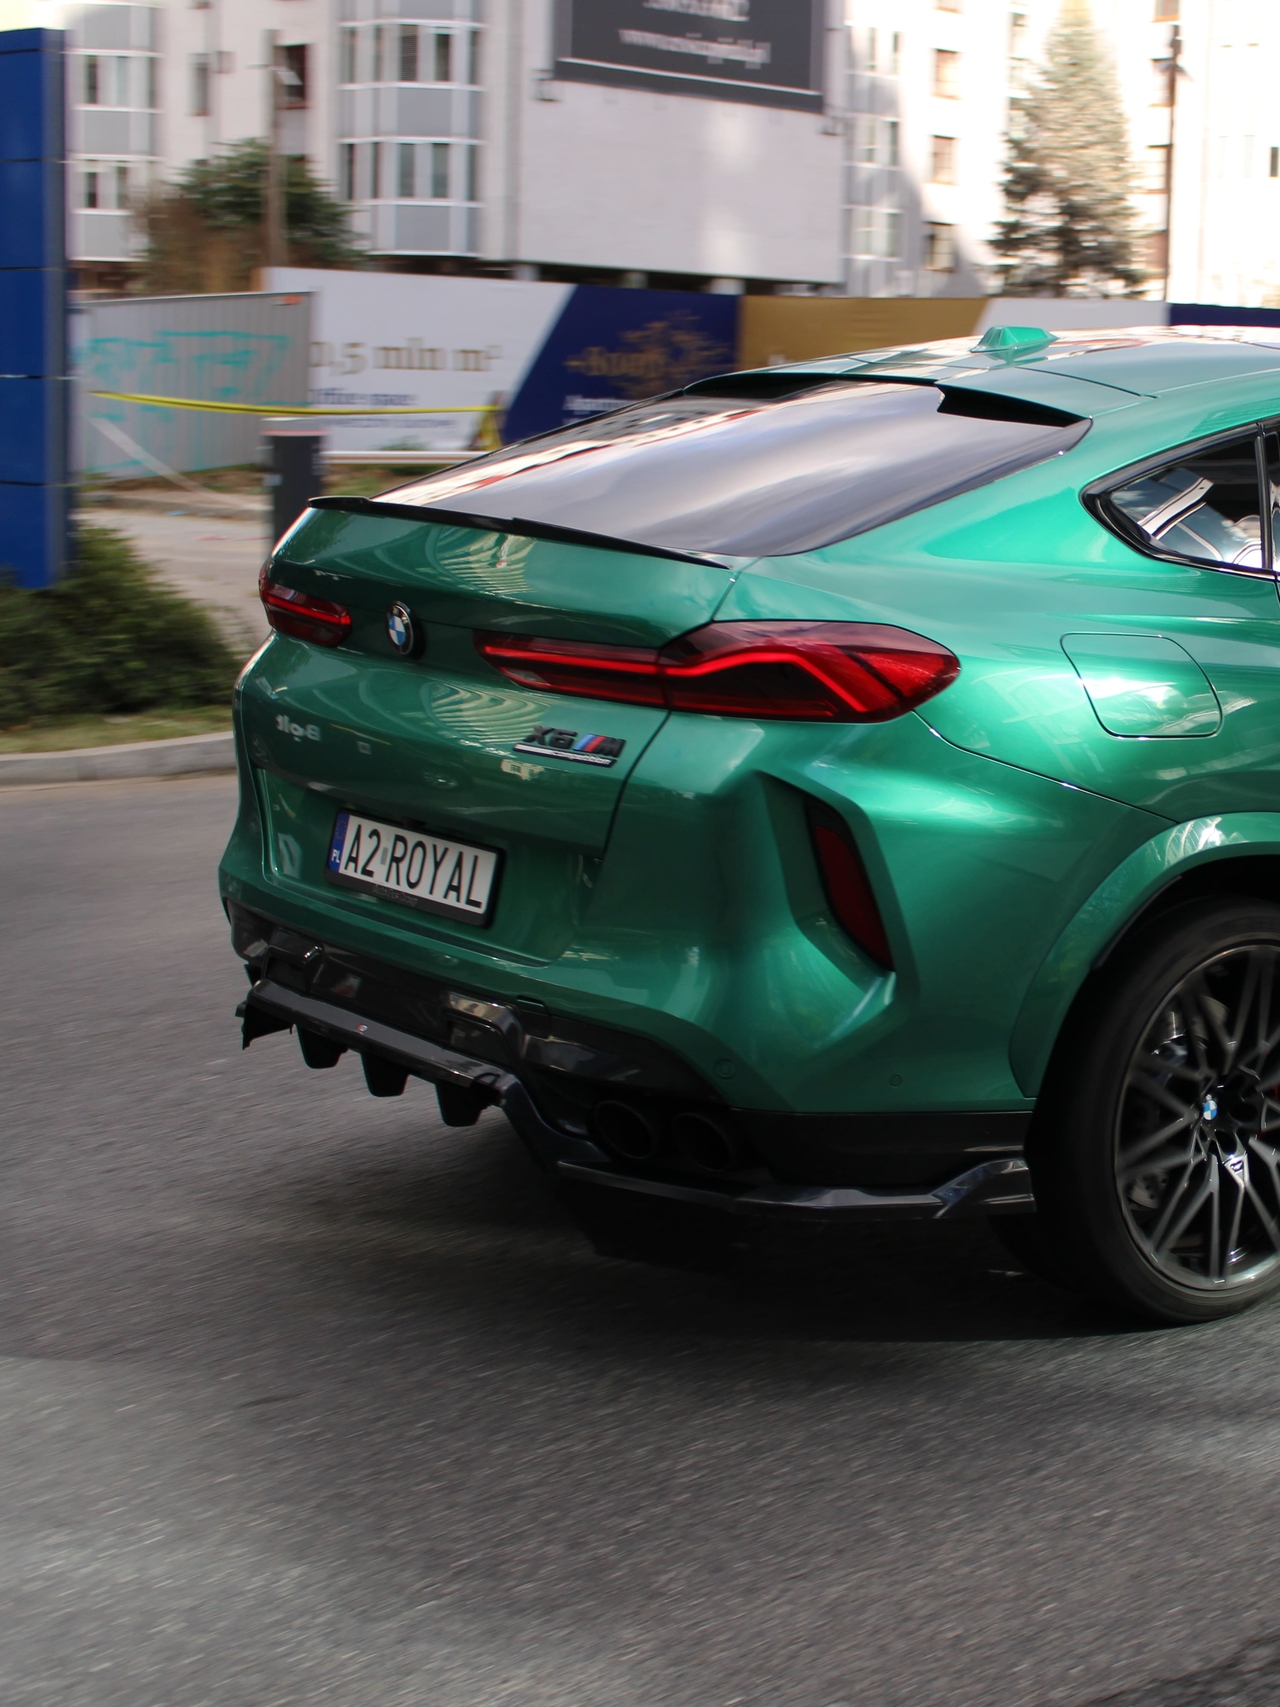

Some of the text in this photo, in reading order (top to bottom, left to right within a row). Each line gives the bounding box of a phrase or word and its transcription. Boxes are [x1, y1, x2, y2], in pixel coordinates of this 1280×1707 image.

[523, 725, 578, 749] X6
[331, 849, 341, 863] PL
[344, 824, 482, 909] A2 ROYAL
